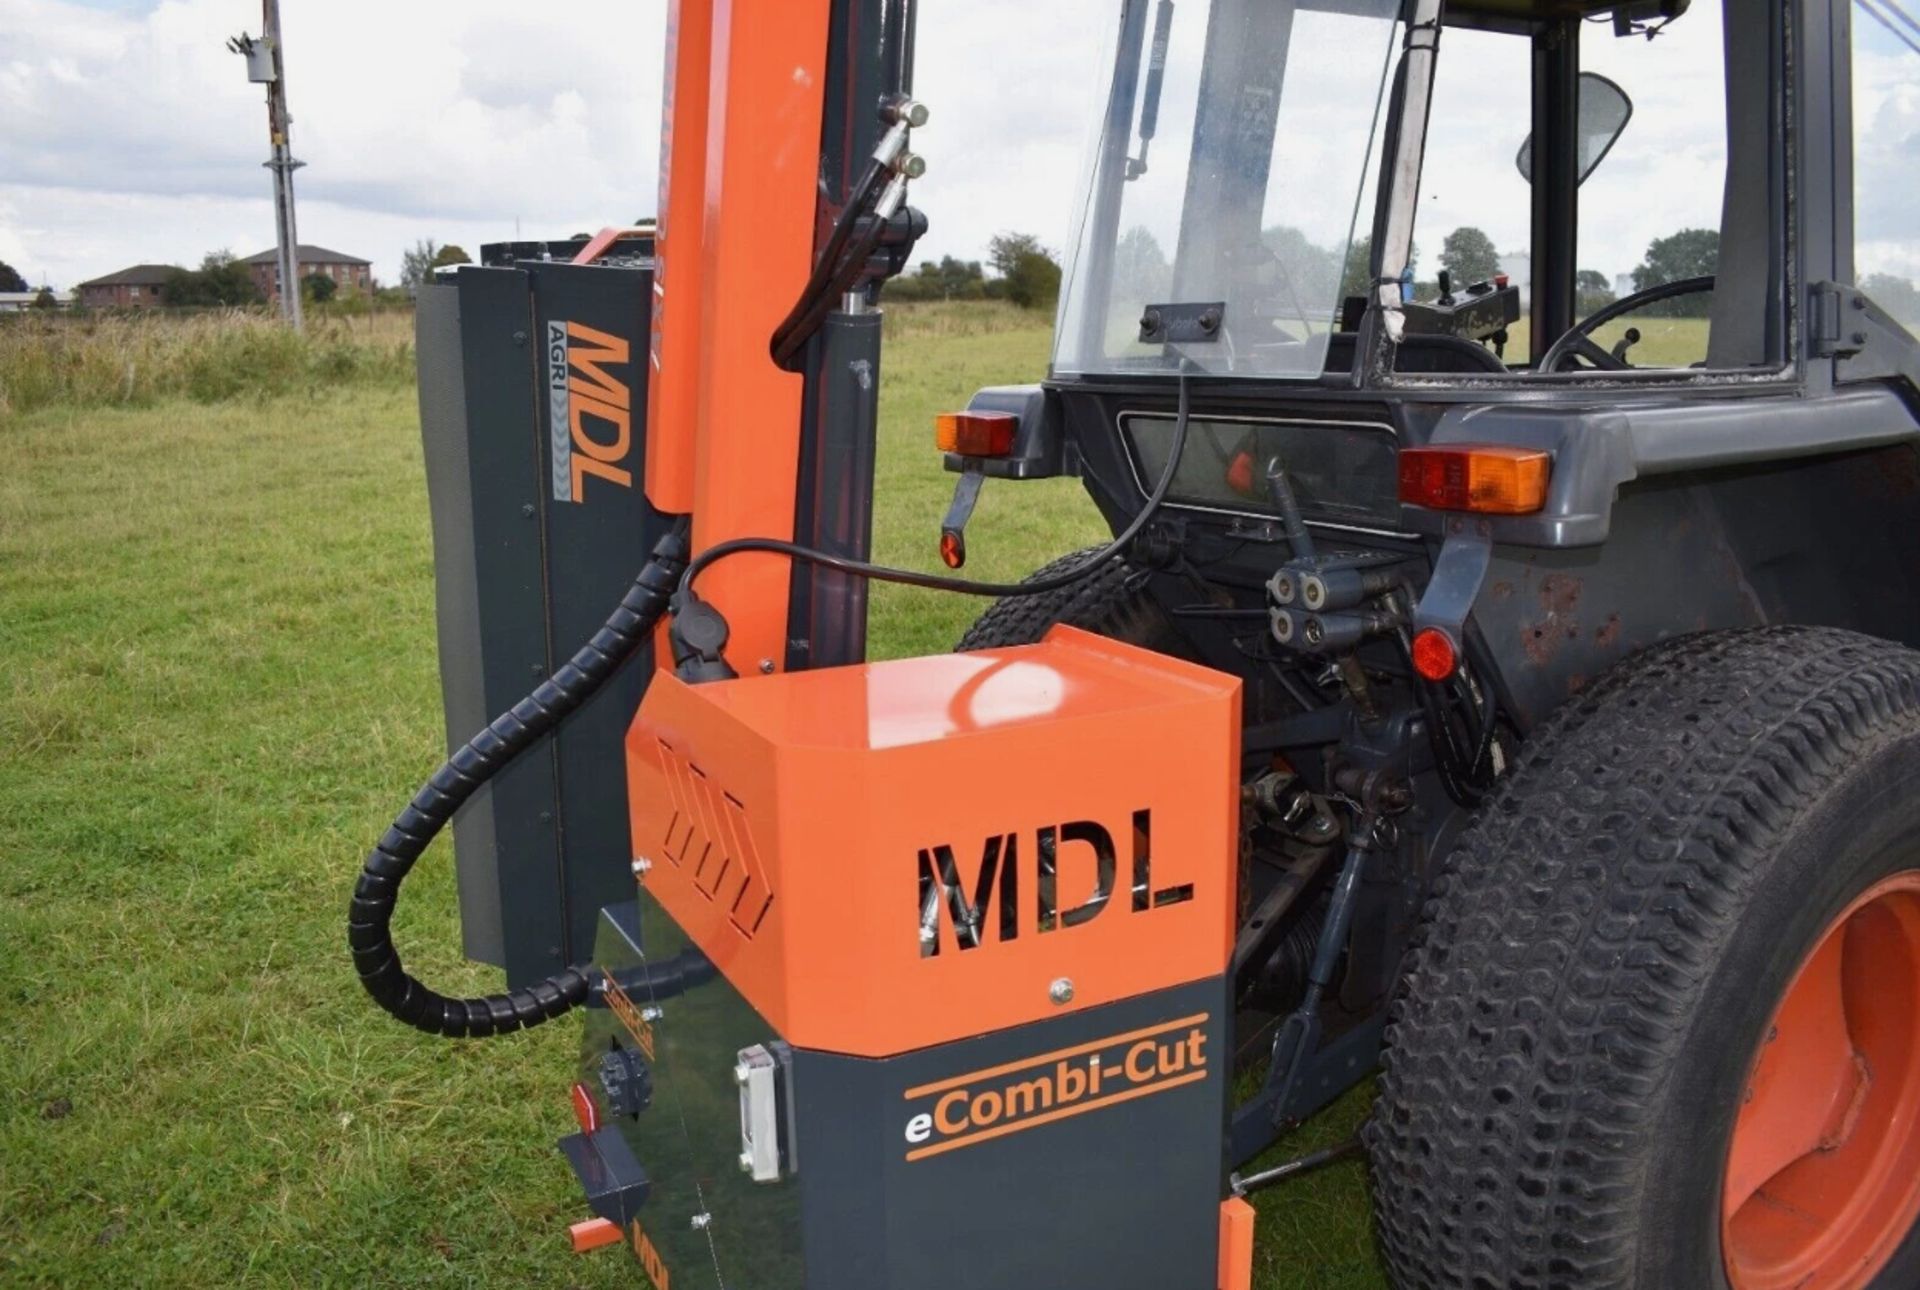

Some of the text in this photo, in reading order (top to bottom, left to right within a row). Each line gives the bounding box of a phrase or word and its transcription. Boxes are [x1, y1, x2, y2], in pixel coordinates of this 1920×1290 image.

[550, 326, 566, 390] AGRI
[567, 320, 632, 503] MDL
[918, 808, 1194, 958] MDL
[906, 1029, 1207, 1143] eCombi-Cut
